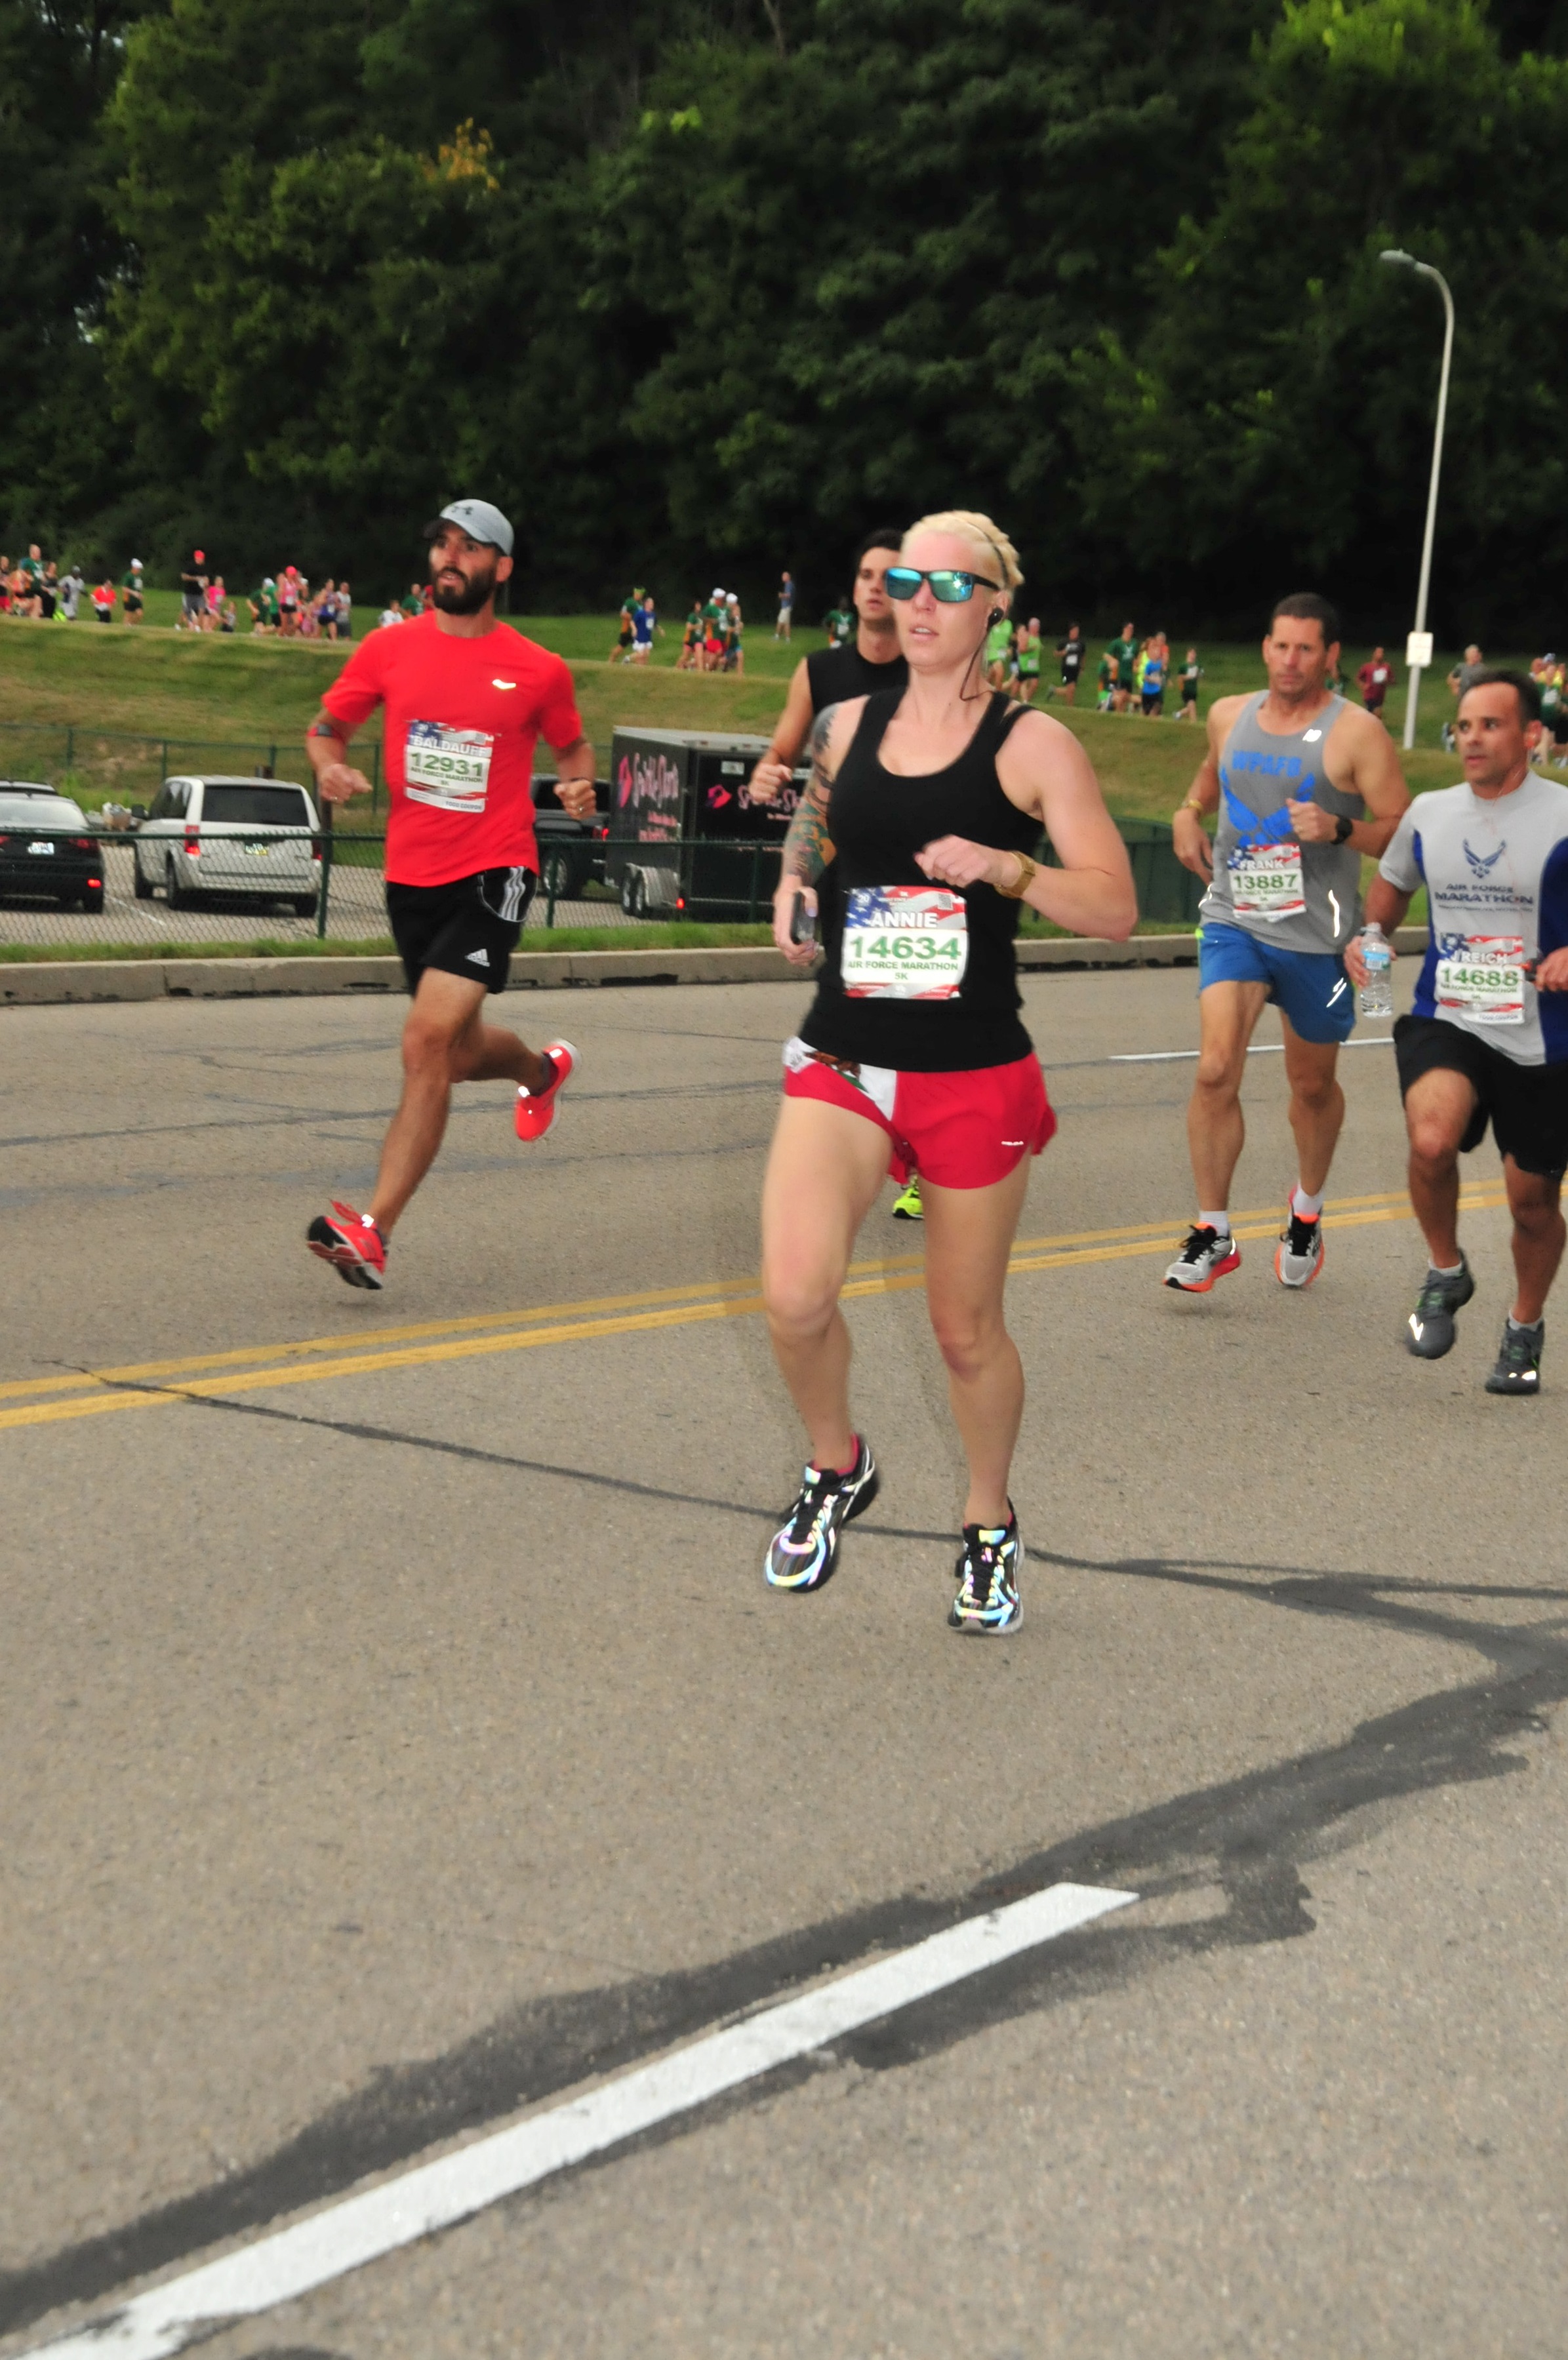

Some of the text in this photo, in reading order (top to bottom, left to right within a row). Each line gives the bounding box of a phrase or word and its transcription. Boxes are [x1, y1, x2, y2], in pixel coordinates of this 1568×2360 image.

[411, 753, 483, 777] 12931
[445, 774, 483, 784] MARATHON
[1240, 858, 1285, 870] FRANK
[1234, 874, 1298, 889] 13887
[1434, 892, 1533, 904] MARATHON
[870, 912, 938, 928] ANNIE
[850, 935, 961, 961] 14634
[866, 961, 898, 969] FORCE
[901, 961, 958, 970] MARATHON
[895, 972, 909, 980] 5K
[1441, 967, 1519, 987] 14688
